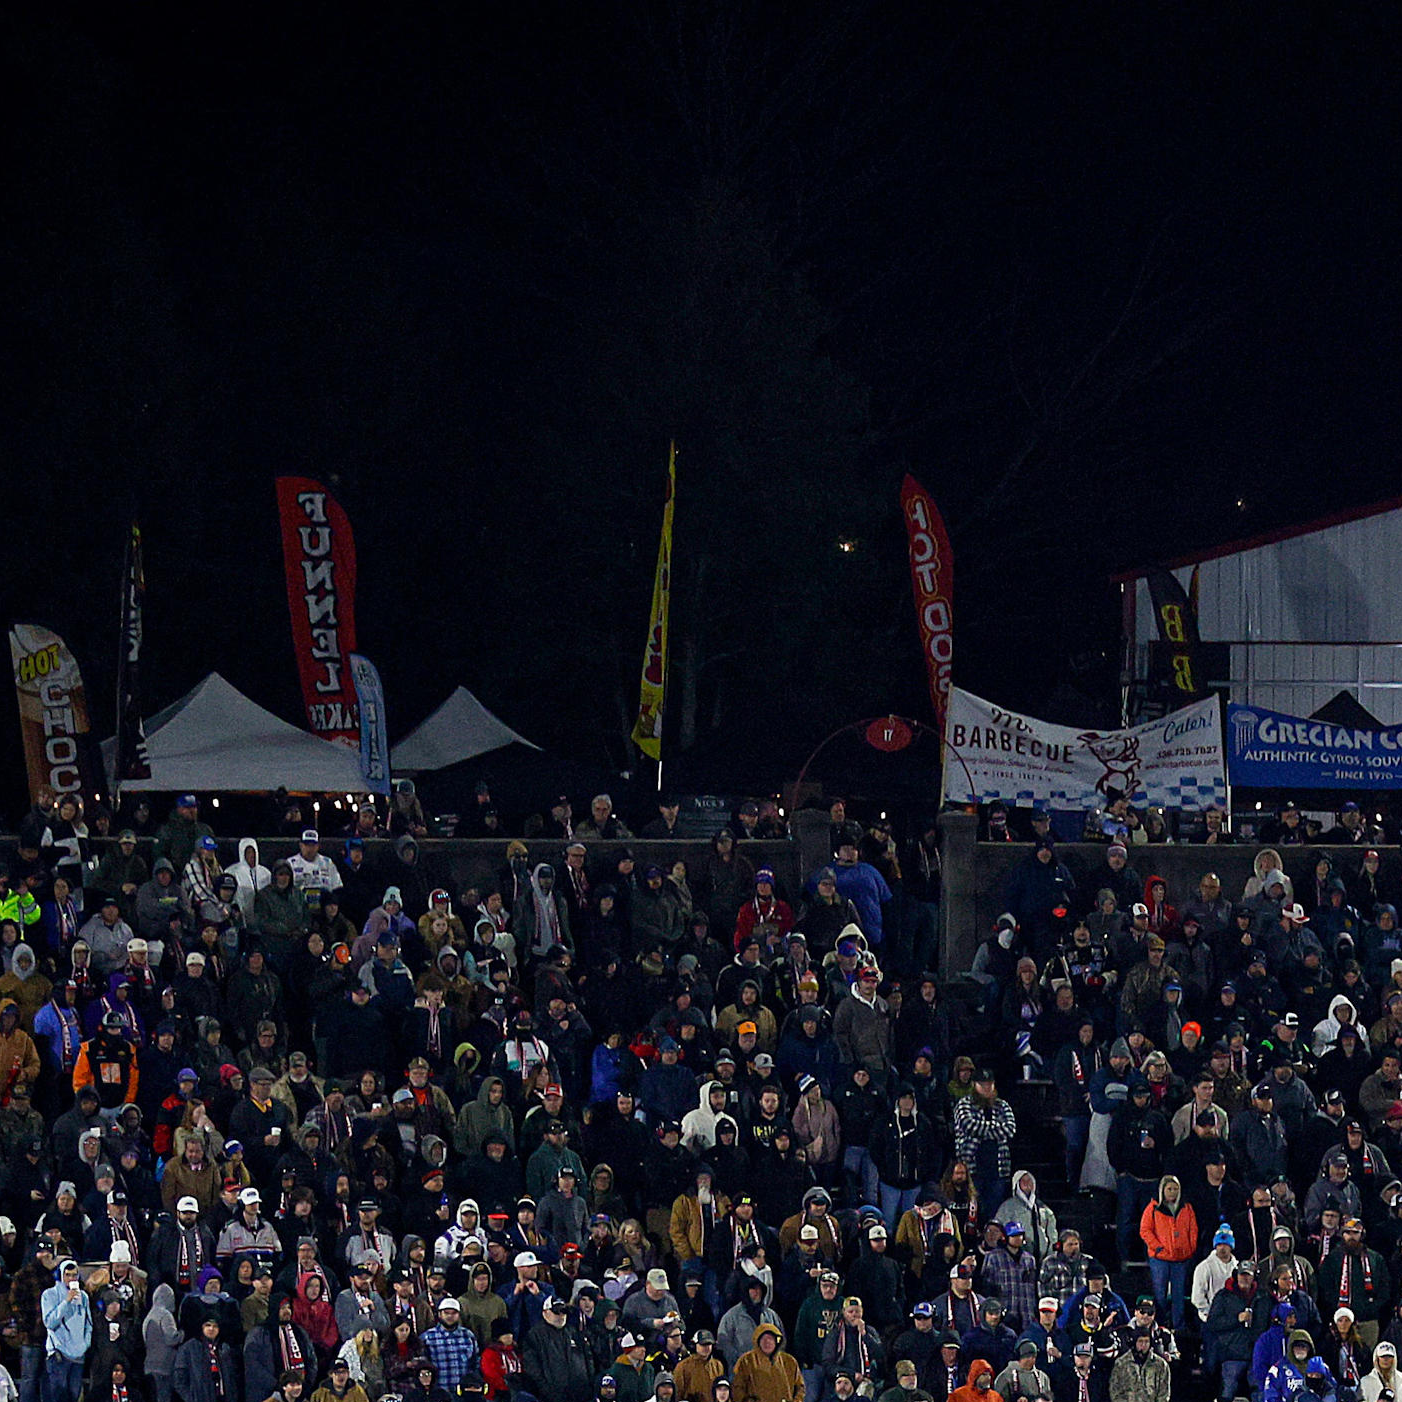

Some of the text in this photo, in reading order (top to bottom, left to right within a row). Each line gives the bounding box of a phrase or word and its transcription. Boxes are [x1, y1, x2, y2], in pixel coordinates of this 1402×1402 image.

[18, 645, 61, 683] HOT
[953, 724, 1075, 764] BARBECUE
[1258, 717, 1374, 750] GRECIAN
[1244, 750, 1315, 764] AUTHENTIC
[1320, 753, 1364, 767] GYROS,
[1334, 769, 1364, 780] SINCE
